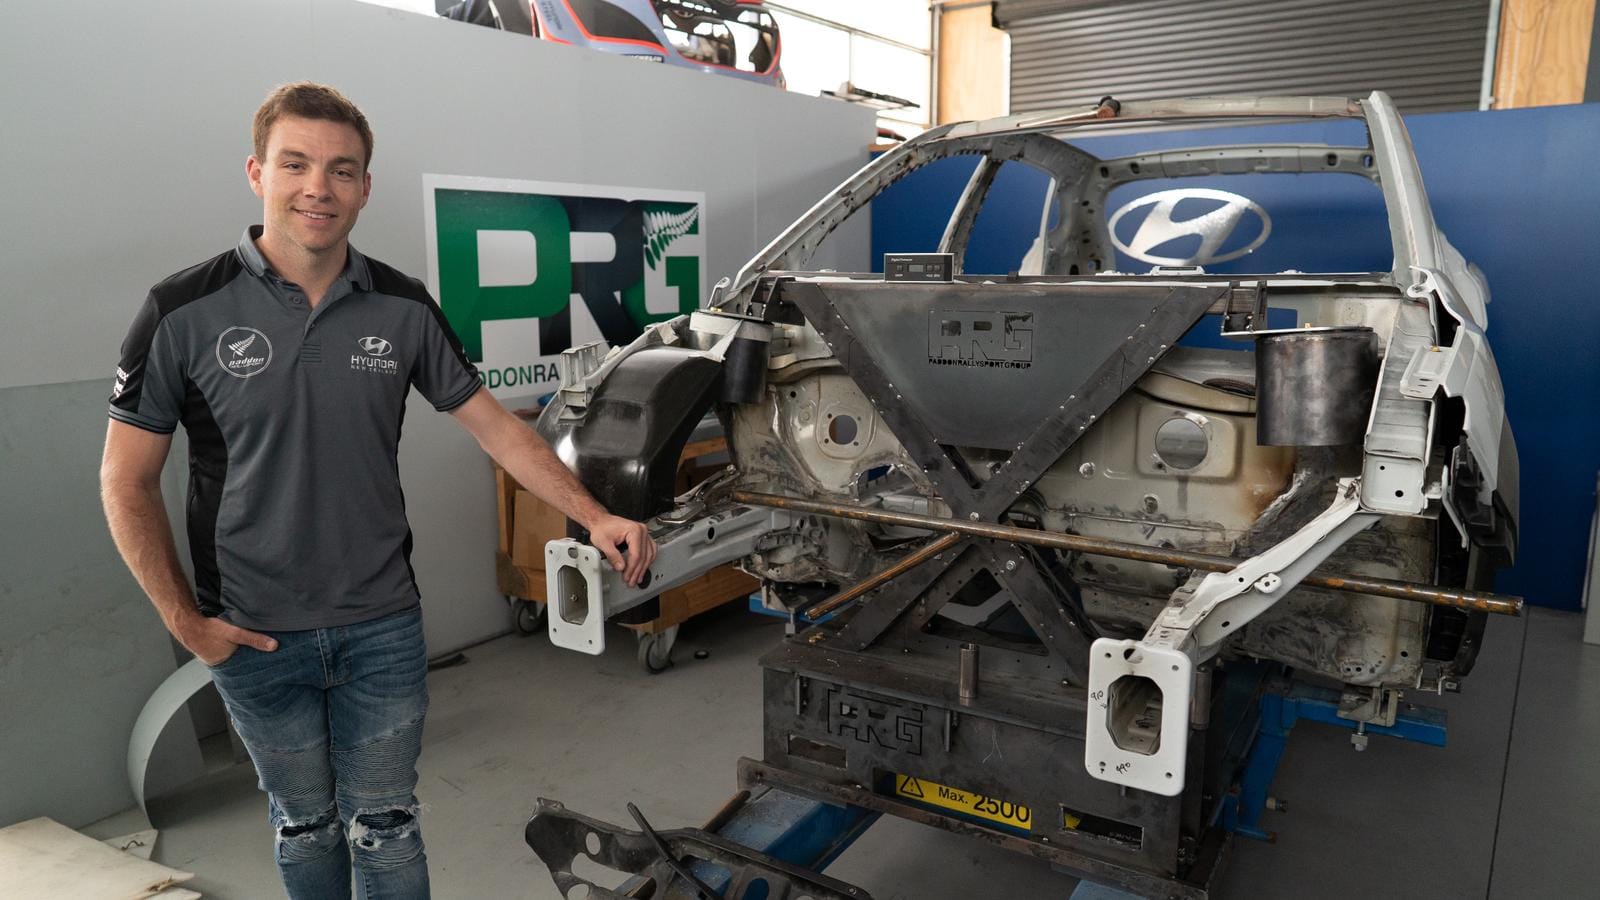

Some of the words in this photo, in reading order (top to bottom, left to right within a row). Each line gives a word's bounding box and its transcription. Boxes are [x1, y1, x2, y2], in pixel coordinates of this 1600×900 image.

[434, 188, 700, 363] PRG
[351, 355, 398, 370] HYUNDAI
[938, 786, 968, 804] Max.
[973, 794, 1030, 823] 2500
